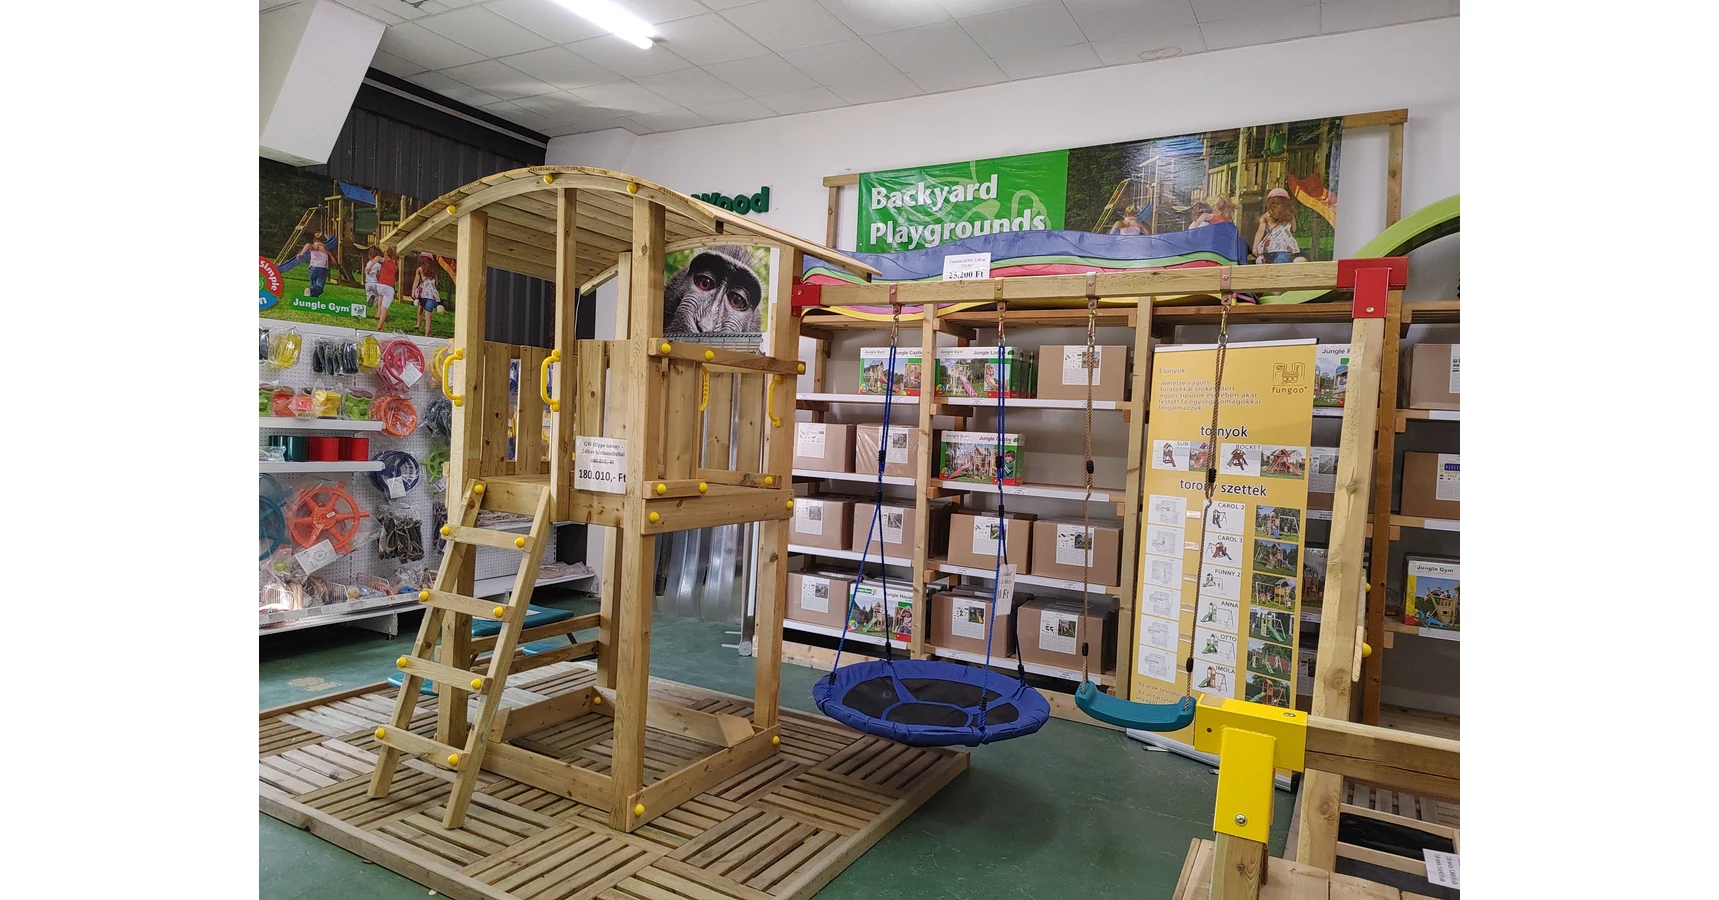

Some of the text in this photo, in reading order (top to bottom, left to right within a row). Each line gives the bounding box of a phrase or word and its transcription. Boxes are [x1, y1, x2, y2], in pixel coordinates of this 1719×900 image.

[871, 174, 998, 211] Backyard
[870, 209, 1046, 250] Playgrounds
[949, 270, 984, 279] 25.200 Ft
[293, 298, 350, 313] Jungle Gym
[1271, 385, 1304, 395] fungoo
[1200, 426, 1248, 439] tonyok
[578, 469, 627, 483] 180.010,- Ft
[1221, 484, 1267, 497] szettek
[1218, 502, 1239, 510] CAROL
[1215, 568, 1236, 577] FUNNY
[1440, 566, 1454, 574] Gym
[1221, 600, 1239, 609] ANNA
[1220, 634, 1237, 642] OTTO
[1215, 665, 1235, 675] IMOLA
